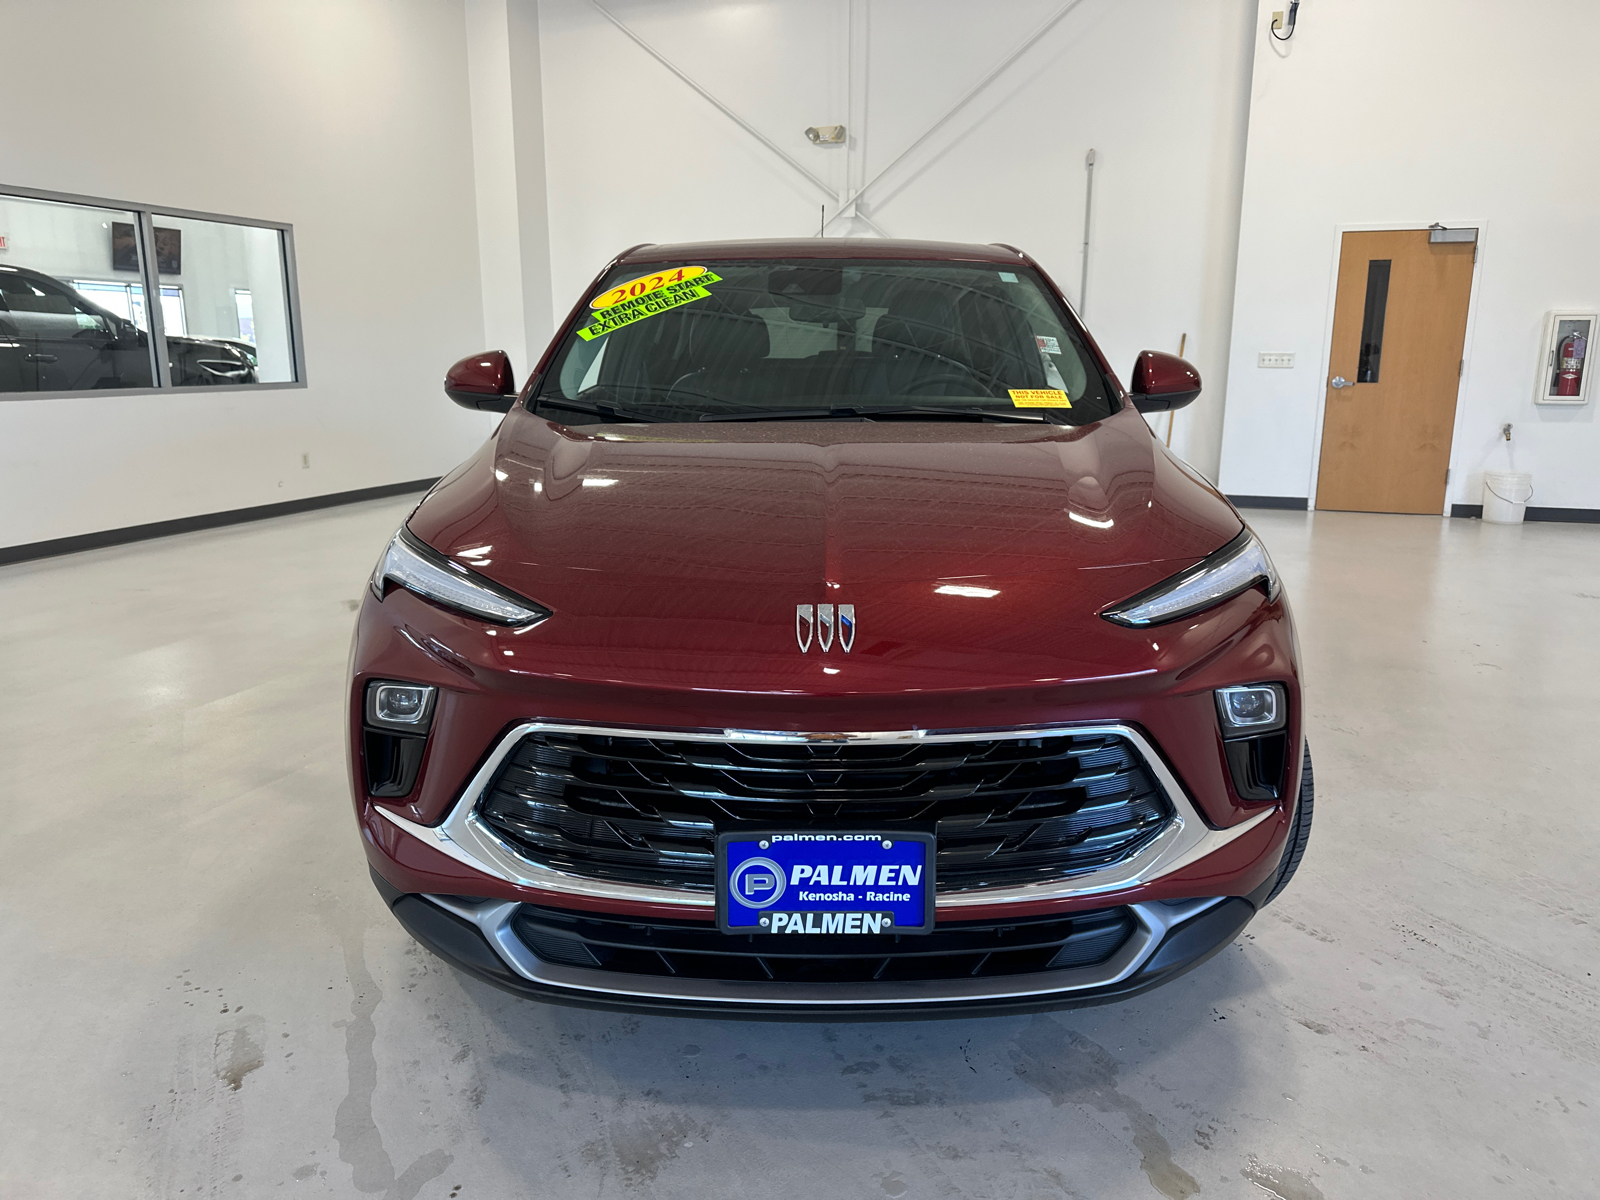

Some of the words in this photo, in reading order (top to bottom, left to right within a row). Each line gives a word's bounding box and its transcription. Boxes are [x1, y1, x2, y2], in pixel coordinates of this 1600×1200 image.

[600, 290, 664, 320] REMOTE
[667, 274, 714, 294] START
[611, 269, 685, 305] 2024
[588, 309, 646, 336] EXTRA
[771, 834, 882, 842] palmen.com
[789, 864, 922, 886] PALMEN
[799, 891, 855, 902] Kenosha
[866, 891, 911, 902] Racine
[770, 912, 883, 934] PALMEN
